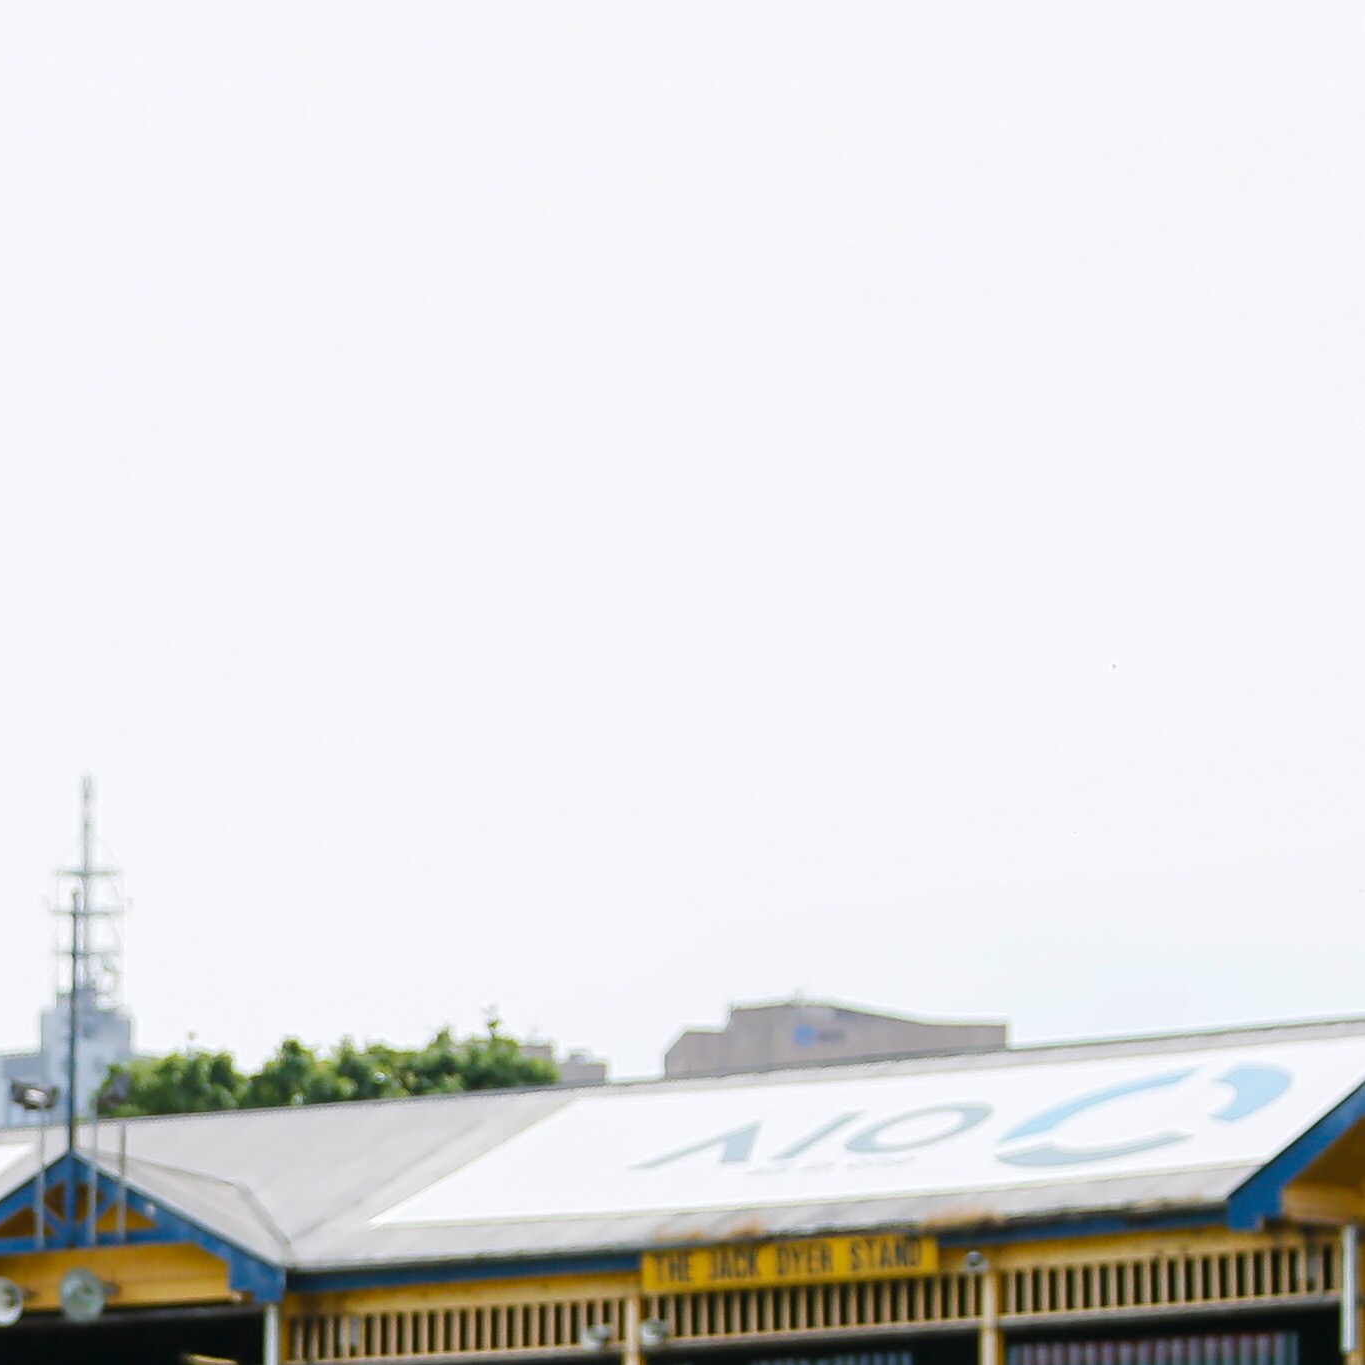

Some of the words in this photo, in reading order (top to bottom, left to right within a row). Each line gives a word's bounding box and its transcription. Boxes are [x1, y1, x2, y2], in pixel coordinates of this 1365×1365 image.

[656, 1251, 691, 1283] THE
[711, 1247, 758, 1279] JACK
[777, 1243, 832, 1275] DYER
[850, 1238, 920, 1271] STAND
